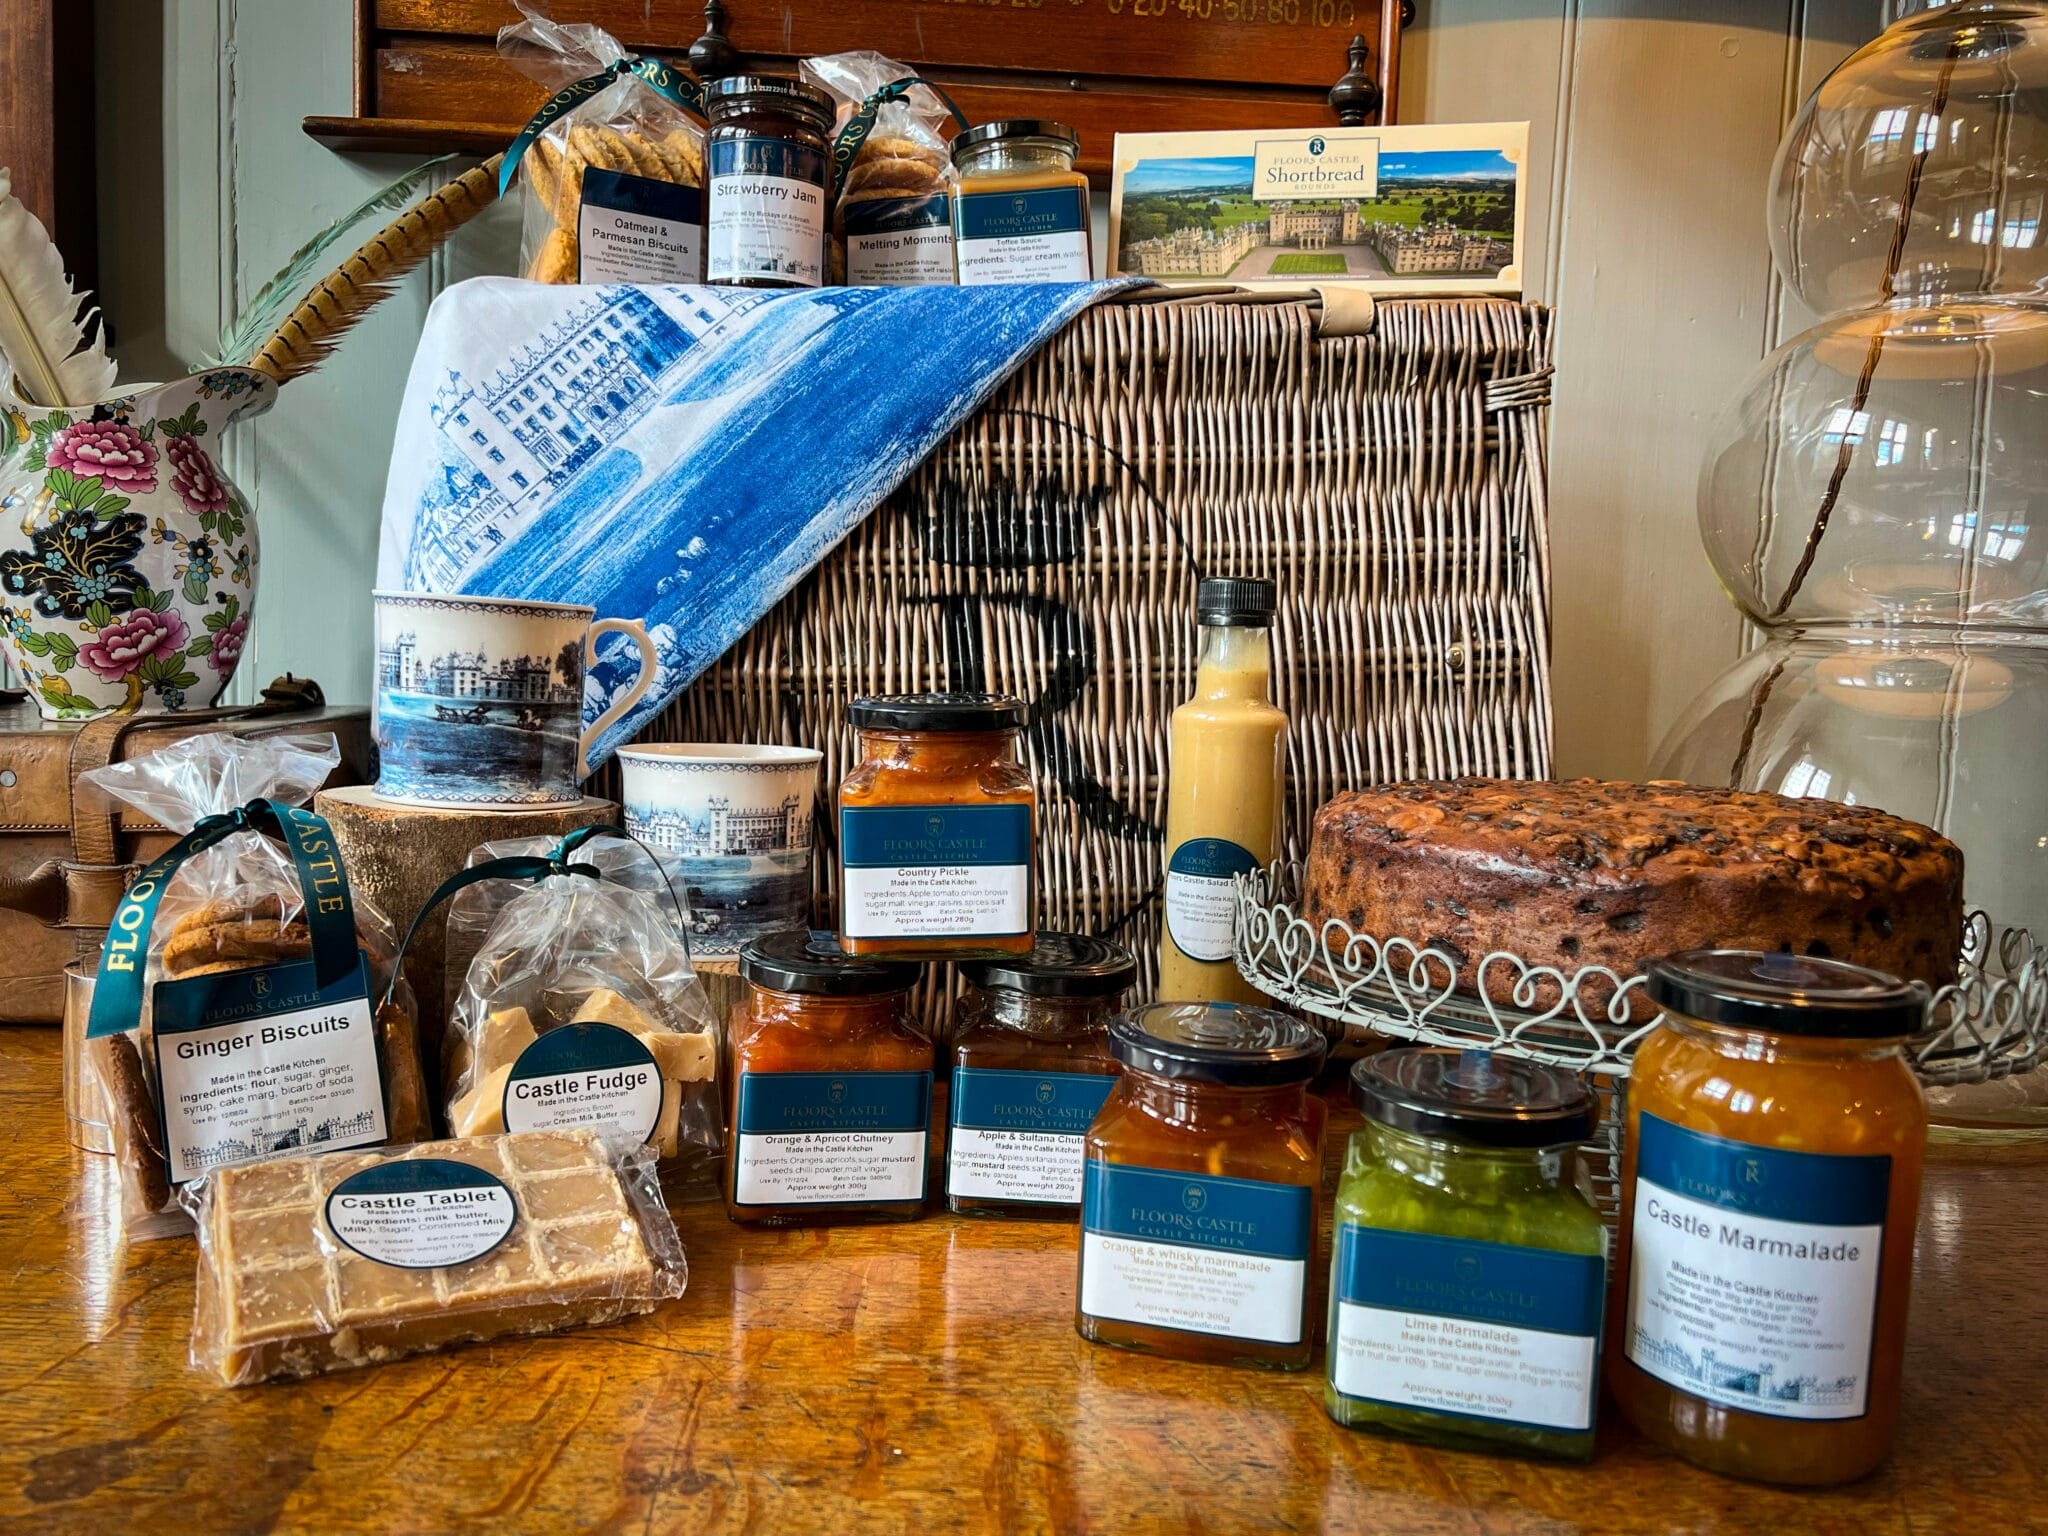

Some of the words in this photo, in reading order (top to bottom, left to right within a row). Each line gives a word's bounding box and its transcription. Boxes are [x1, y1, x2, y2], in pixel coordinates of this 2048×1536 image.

[1319, 156, 1359, 164] CASTLE
[1267, 165, 1363, 183] Shortbread
[717, 183, 788, 200] Strawberry
[793, 189, 816, 204] Jam
[1023, 213, 1057, 223] CASTLE
[615, 218, 658, 235] Oatmeal
[661, 227, 668, 236] &
[593, 228, 645, 246] Parmesan
[648, 238, 688, 254] Biscuits
[859, 239, 899, 250] Melting
[903, 235, 952, 246] Moments
[884, 840, 935, 850] FLOORS
[939, 839, 986, 849] CASTLE
[288, 809, 344, 913] CASTLE
[898, 869, 936, 878] Country
[940, 868, 969, 876] Pickle
[926, 916, 952, 924] weight
[206, 1002, 264, 1020] FLOORS
[268, 991, 320, 1008] CASTLE
[177, 1034, 254, 1059] Ginger
[261, 1016, 350, 1044] Biscuits
[211, 1076, 235, 1085] Made
[248, 1070, 262, 1078] the
[264, 1064, 291, 1075] Castle
[293, 1057, 326, 1069] Kitchen
[220, 1095, 244, 1108] cake
[282, 1083, 312, 1095] bicarb
[316, 1078, 326, 1088] of
[329, 1076, 353, 1086] soda
[516, 1079, 579, 1099] Castle
[587, 1072, 647, 1091] Fudge
[579, 1093, 600, 1101] Castle
[601, 1090, 628, 1099] Kitchen
[263, 1109, 290, 1121] weight
[784, 1106, 835, 1117] FLOORS
[840, 1105, 887, 1115] CASTLE
[993, 1105, 1043, 1118] FLOORS
[1048, 1107, 1095, 1119] CASTLE
[553, 1117, 577, 1125] Cream
[579, 1113, 593, 1121] Milk
[765, 1136, 801, 1145] Orange
[815, 1135, 850, 1144] Apricot
[853, 1135, 893, 1144] Chutney
[978, 1131, 1007, 1140] Apple
[1020, 1134, 1055, 1143] Sultana
[342, 1197, 416, 1209] Castle
[424, 1191, 496, 1205] Tablet
[419, 1221, 480, 1231] Condensed
[1131, 1208, 1192, 1230] FLOORS
[1197, 1216, 1256, 1236] CASTLE
[1139, 1227, 1182, 1239] CASTLE
[1190, 1233, 1244, 1247] KITCHEN
[1647, 1199, 1710, 1239] Castle
[1718, 1222, 1860, 1262] Marmalade
[1102, 1240, 1143, 1258] Orange
[1148, 1247, 1154, 1256] &
[1159, 1249, 1201, 1263] whisky
[1204, 1256, 1271, 1272] marmalade
[1165, 1261, 1177, 1270] the
[1713, 1274, 1731, 1289] the
[1135, 1301, 1169, 1313] Approx
[1404, 1316, 1438, 1332] Lime
[1442, 1323, 1519, 1344] Marmalade
[1438, 1335, 1453, 1346] the
[1402, 1381, 1443, 1395] Approx
